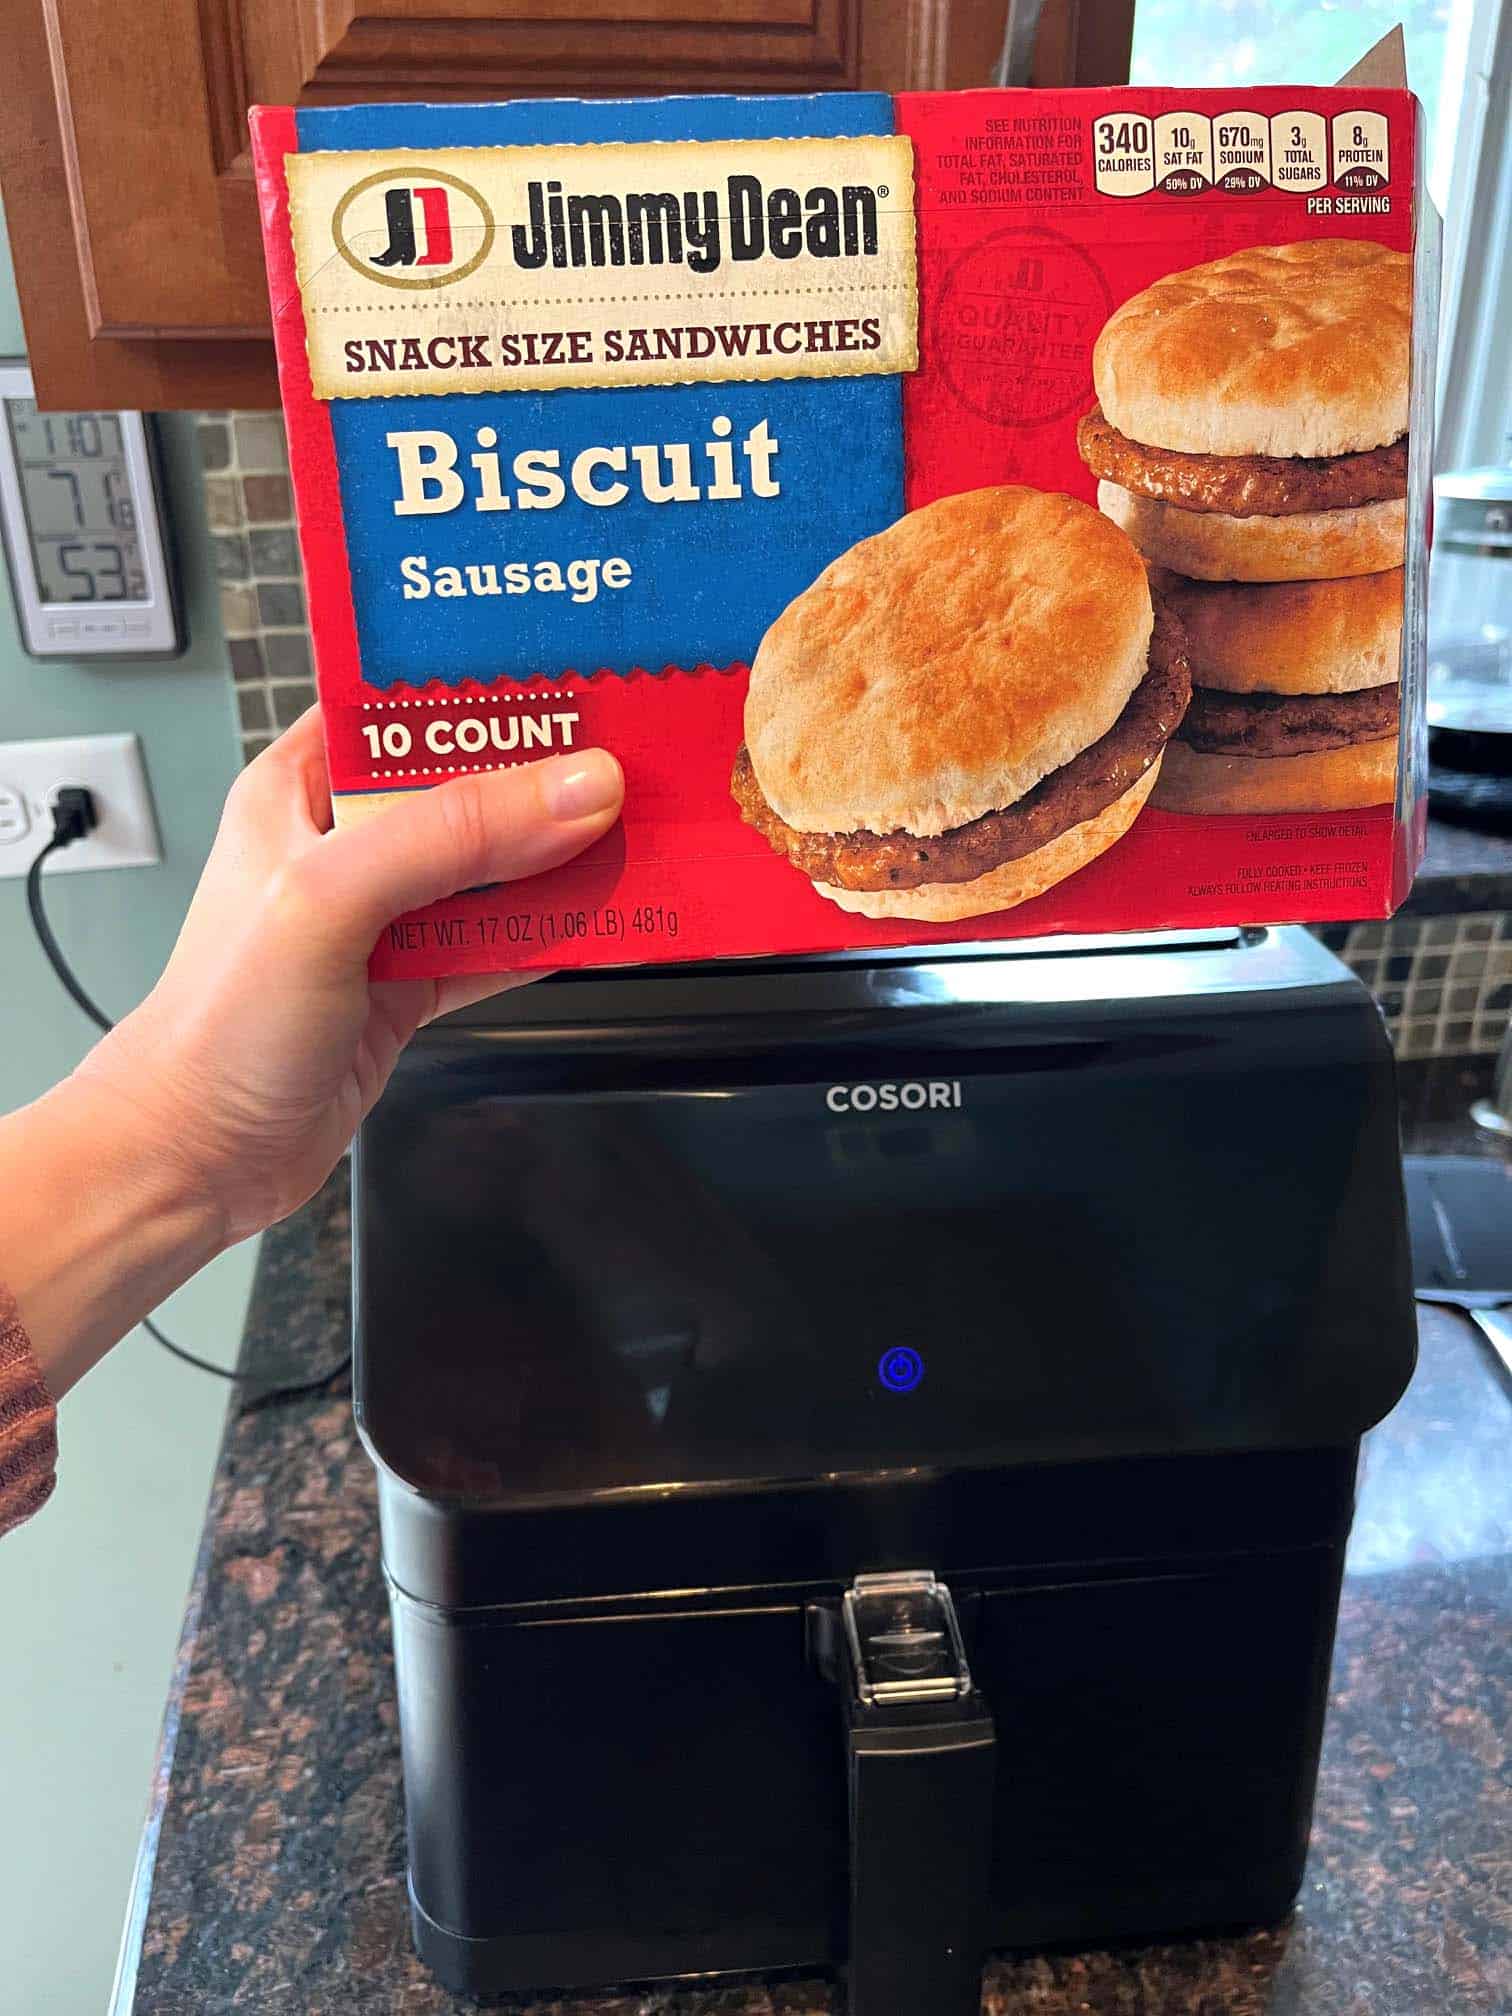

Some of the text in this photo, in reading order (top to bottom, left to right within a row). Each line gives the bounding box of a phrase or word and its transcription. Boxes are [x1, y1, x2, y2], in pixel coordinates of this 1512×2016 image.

[986, 118, 1081, 132] SEE NUTRITION
[966, 135, 1082, 150] INFORMATION FOR
[1100, 122, 1148, 154] 340
[936, 155, 976, 169] TOTAL
[1009, 152, 1083, 167] SATURATED
[1164, 152, 1204, 165] SAT FAT
[1220, 151, 1264, 164] SODIUM
[1284, 150, 1314, 163] TOTAL
[1339, 150, 1383, 163] PROTEIN
[1098, 158, 1151, 172] CALORIES
[1278, 167, 1321, 180] SUGARS
[1345, 175, 1379, 187] 11% DV
[1166, 178, 1203, 190] 50% DV
[1224, 176, 1261, 189] 29% DV
[940, 187, 1084, 204] AND SODIUM CONTENT
[1308, 196, 1390, 214] PER SERVING
[512, 180, 719, 273] Jimmy
[344, 317, 882, 373] SNACK SIZE SANDWICHES
[386, 415, 781, 516] Biscuit
[400, 555, 633, 603] Sausage
[362, 711, 580, 759] 10 COUNT
[391, 906, 679, 951] NET WT. 17 OZ (1.06 LB) 481g
[826, 1081, 961, 1112] COSORI
